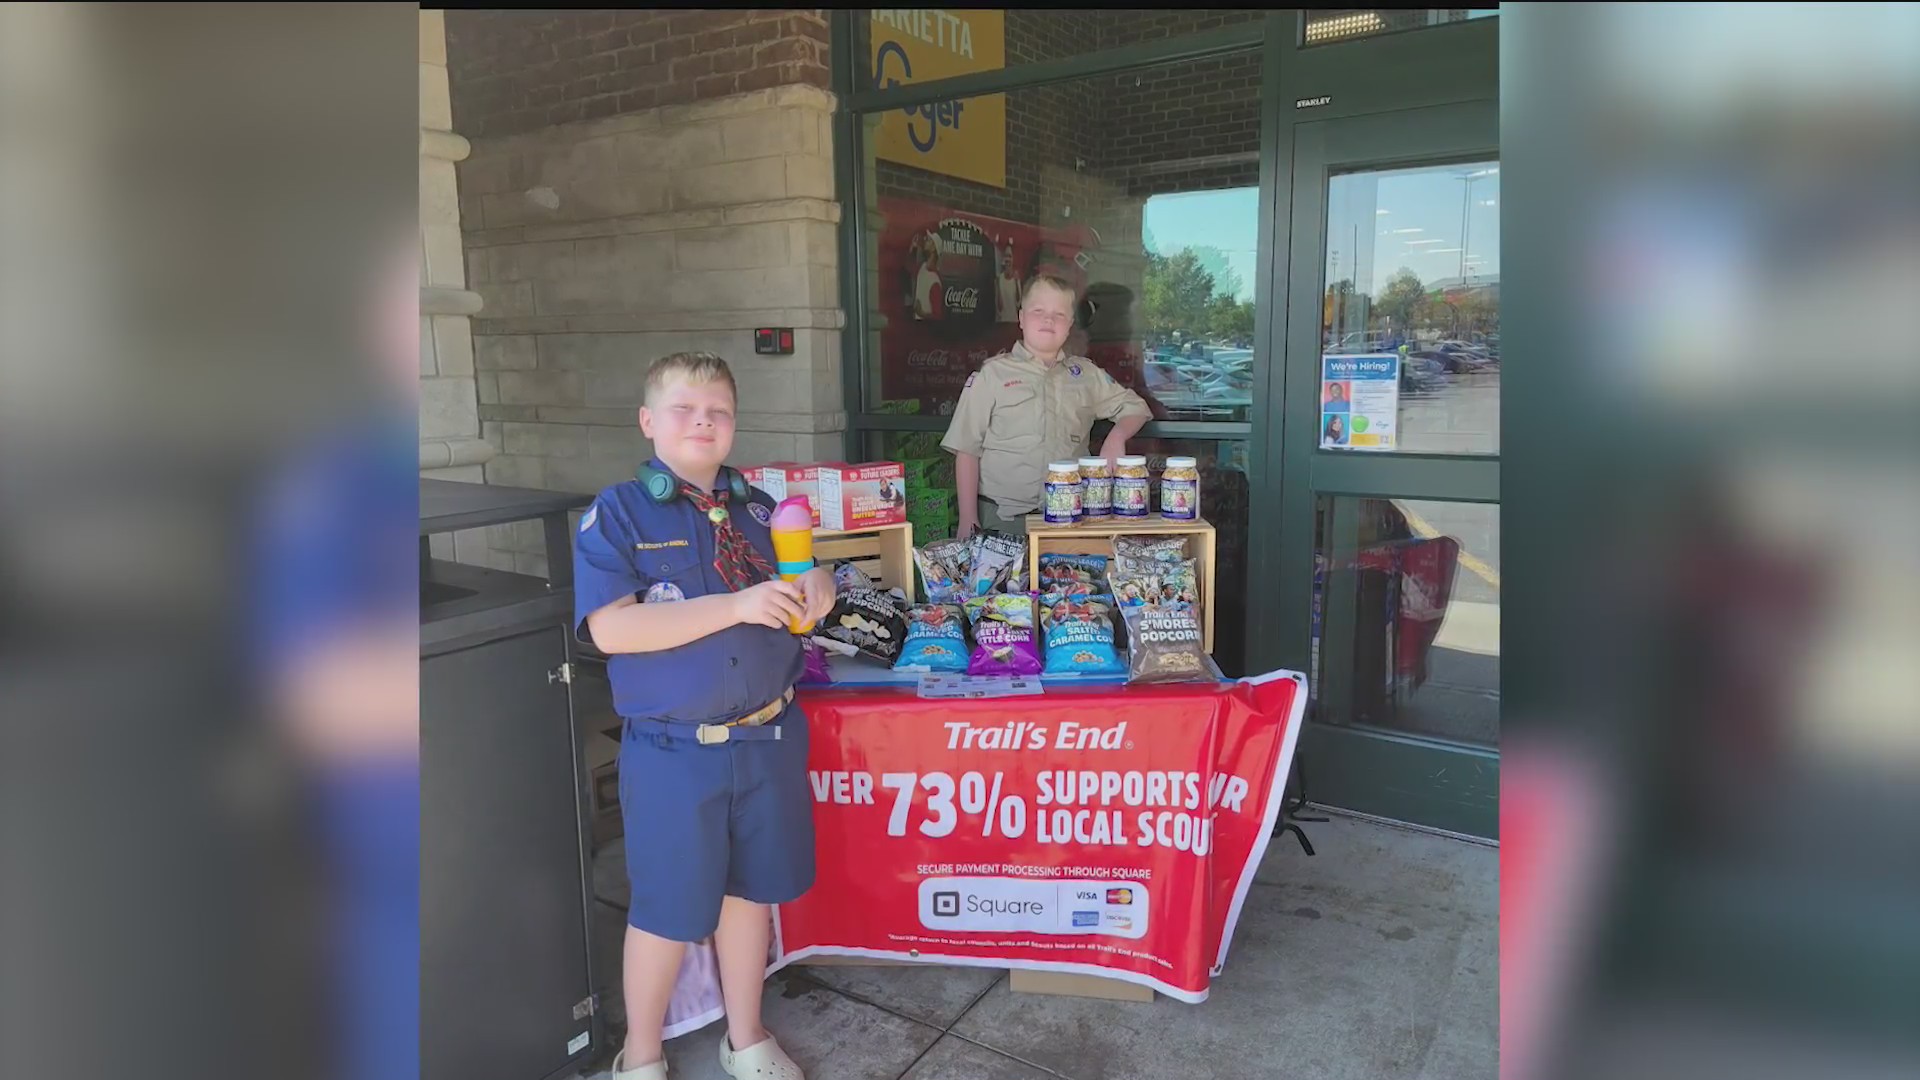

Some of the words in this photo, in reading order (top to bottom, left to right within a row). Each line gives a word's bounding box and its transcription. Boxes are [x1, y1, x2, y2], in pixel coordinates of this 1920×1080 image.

[1296, 97, 1331, 108] STANLEY
[951, 228, 970, 242] TACKLE
[1331, 362, 1358, 371] We're
[1359, 362, 1390, 371] Hiring!
[846, 597, 894, 618] POPCORN
[1140, 619, 1197, 630] S'MORES
[1049, 634, 1094, 648] CARAMEL
[944, 721, 1047, 750] Trail's
[808, 770, 875, 805] VER
[882, 771, 1026, 838] 73%
[1036, 770, 1200, 810] SUPPORTS
[1036, 809, 1128, 845] LOCAL
[1137, 811, 1213, 857] SCOU
[917, 864, 953, 874] SECURE
[955, 864, 1000, 874] PAYMENT
[1002, 864, 1061, 876] PROCESSING
[1063, 867, 1110, 878] THROUGH
[1112, 868, 1152, 879] SQUARE
[1076, 891, 1098, 900] VISA
[967, 894, 1044, 917] Square
[1097, 944, 1116, 954] Trail's
[1118, 947, 1132, 957] End
